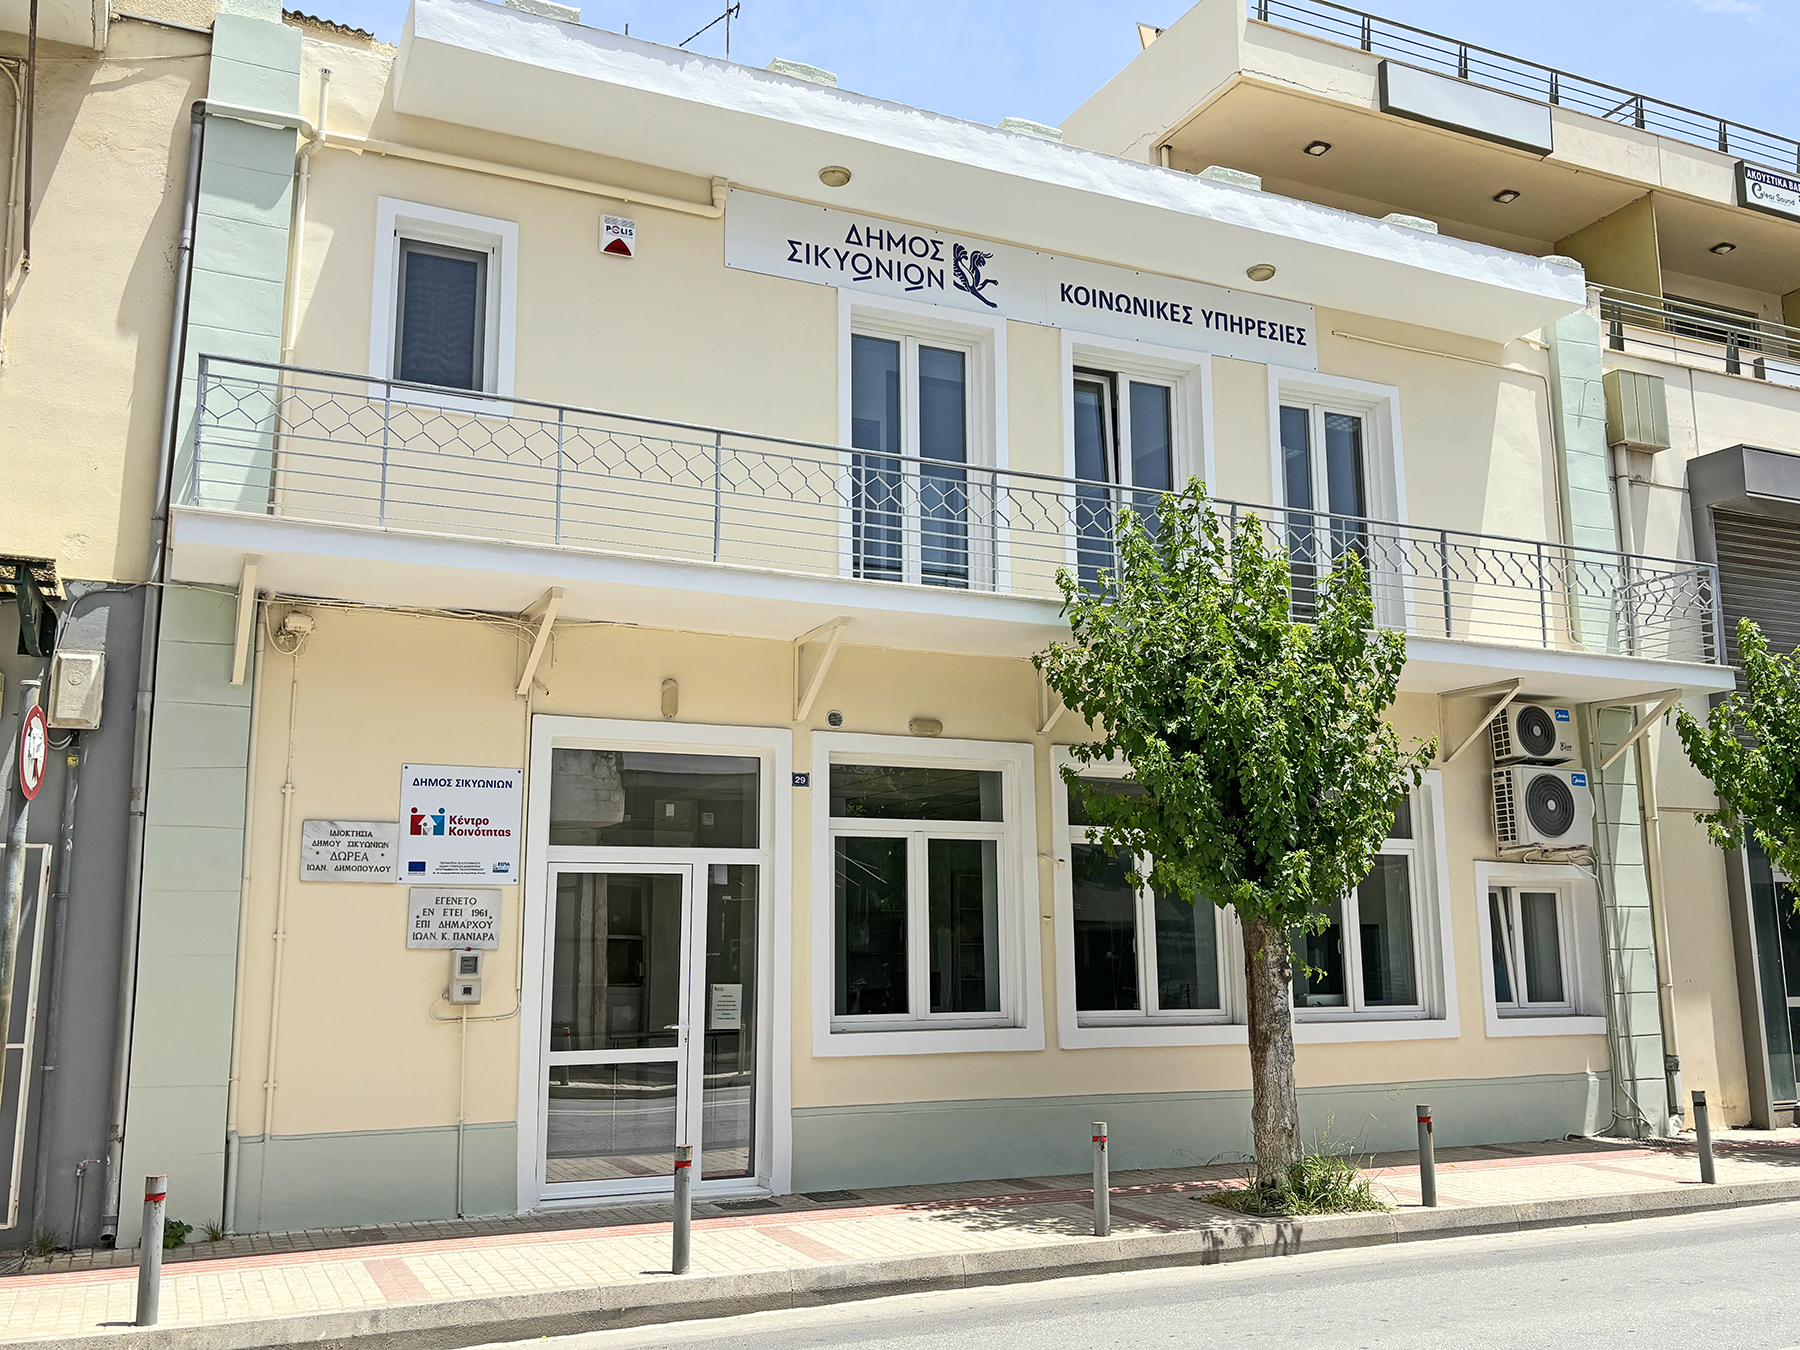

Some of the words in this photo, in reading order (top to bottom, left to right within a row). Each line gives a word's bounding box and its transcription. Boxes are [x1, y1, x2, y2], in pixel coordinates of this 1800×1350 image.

[1746, 168, 1788, 189] ΑΚΟΥΣΤΙΚΑ
[605, 225, 634, 236] POLIS
[844, 223, 945, 262] ΔΗΜΟΣ
[1060, 282, 1193, 325] ΚΟΙΝΩΝΙΚΕΣ
[1201, 308, 1307, 346] ΥΠΗΡΕΣΙΕΣ
[412, 777, 453, 788] ΔΗΜΟΣ
[455, 778, 513, 789] ΣΙΚΥΩΝΙΩΝ
[794, 776, 806, 784] 29
[448, 814, 490, 827] Κέντρο
[329, 829, 374, 838] ΙΔΙΟΚΤΗΣΙΑ
[311, 840, 341, 848] ΔΗΜΟΥ
[347, 840, 390, 849] ΣΙΚΥΩΝΙΩΝ
[329, 851, 369, 862] ΔΩΡΕΑ
[306, 864, 328, 872] ΙΩΑΝ.
[334, 864, 391, 873] ΔΗΜΟΠΟΥΛΟΥ
[435, 896, 477, 906] ΕΓΕΝΕΤΟ
[422, 908, 435, 917] ΕΝ
[443, 908, 463, 917] ΕΤΕΙ
[471, 908, 488, 917] 1961
[415, 920, 430, 929] ΕΠΙ
[438, 920, 494, 929] ΔΗΜΑΡΧΟΥ
[412, 931, 438, 941] ΙΩΑΝ.
[441, 932, 450, 941] Κ.
[453, 932, 495, 941] ΠΑΝΙΑΡΑ
